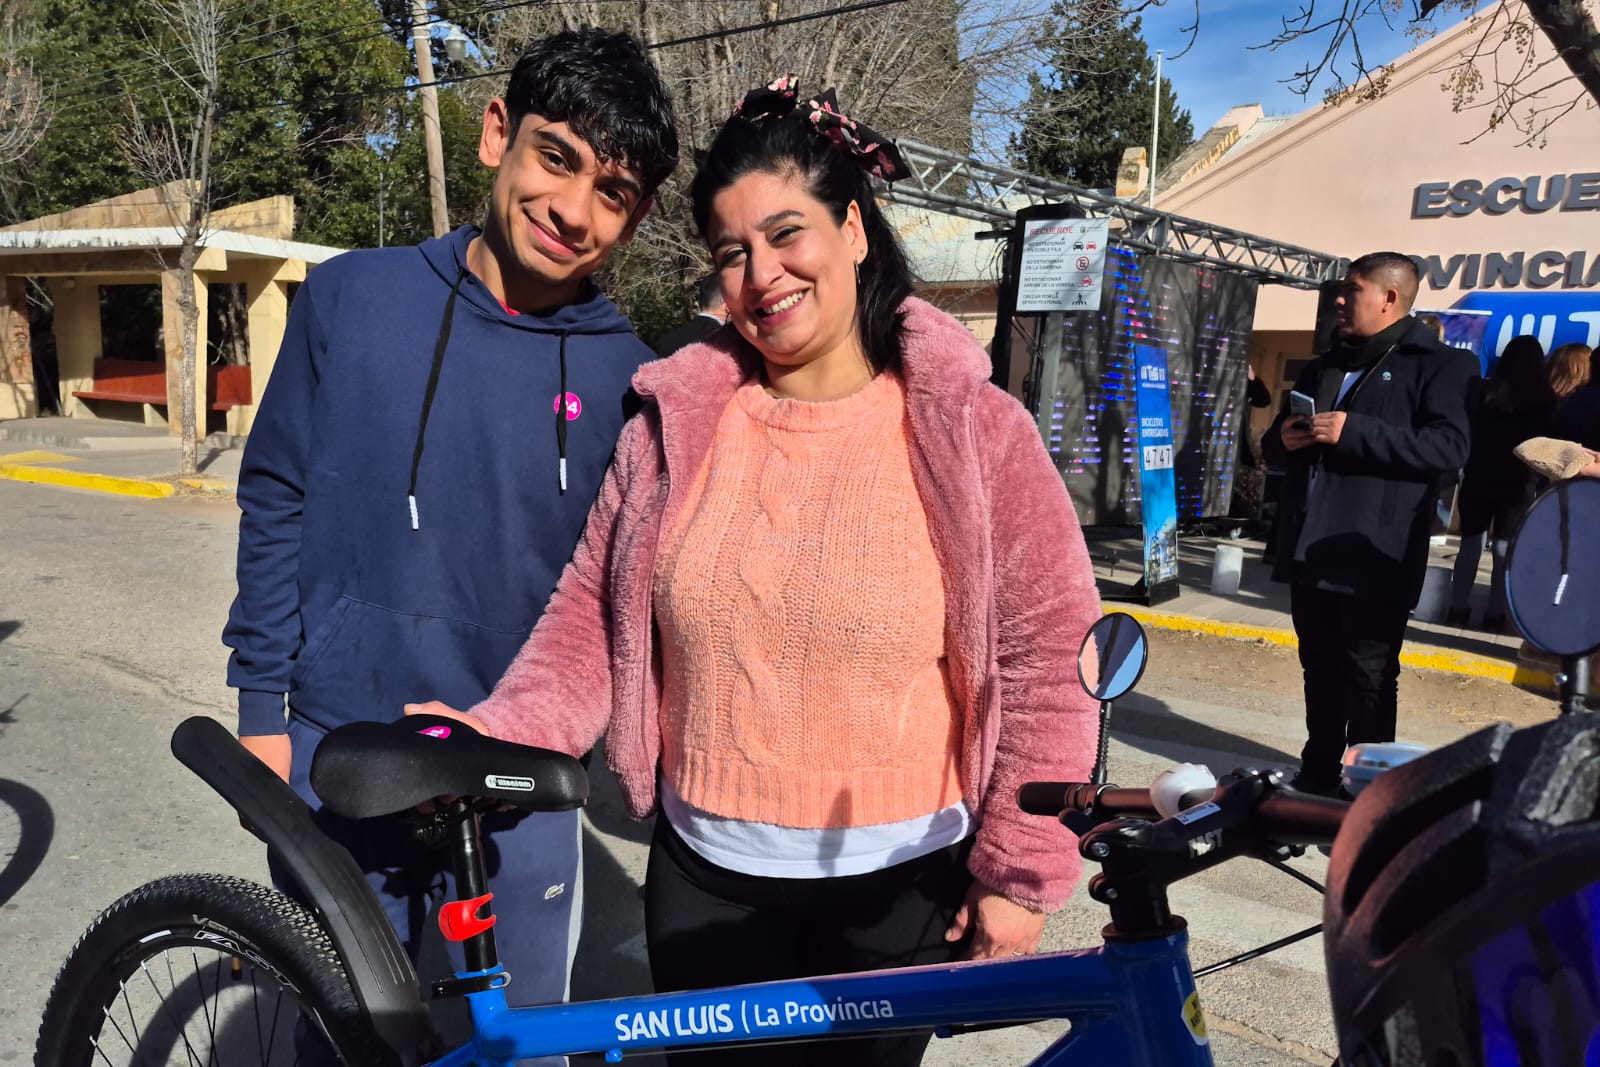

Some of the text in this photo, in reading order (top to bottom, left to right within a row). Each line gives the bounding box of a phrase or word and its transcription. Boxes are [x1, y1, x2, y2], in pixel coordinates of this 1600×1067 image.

[1411, 173, 1600, 219] ESCUE
[1030, 226, 1073, 235] RECUERDE
[1145, 447, 1171, 467] 4747
[614, 1009, 670, 1042] SAN
[673, 1003, 734, 1037] LUIS
[754, 1003, 780, 1027] La
[785, 997, 894, 1025] Provincia
